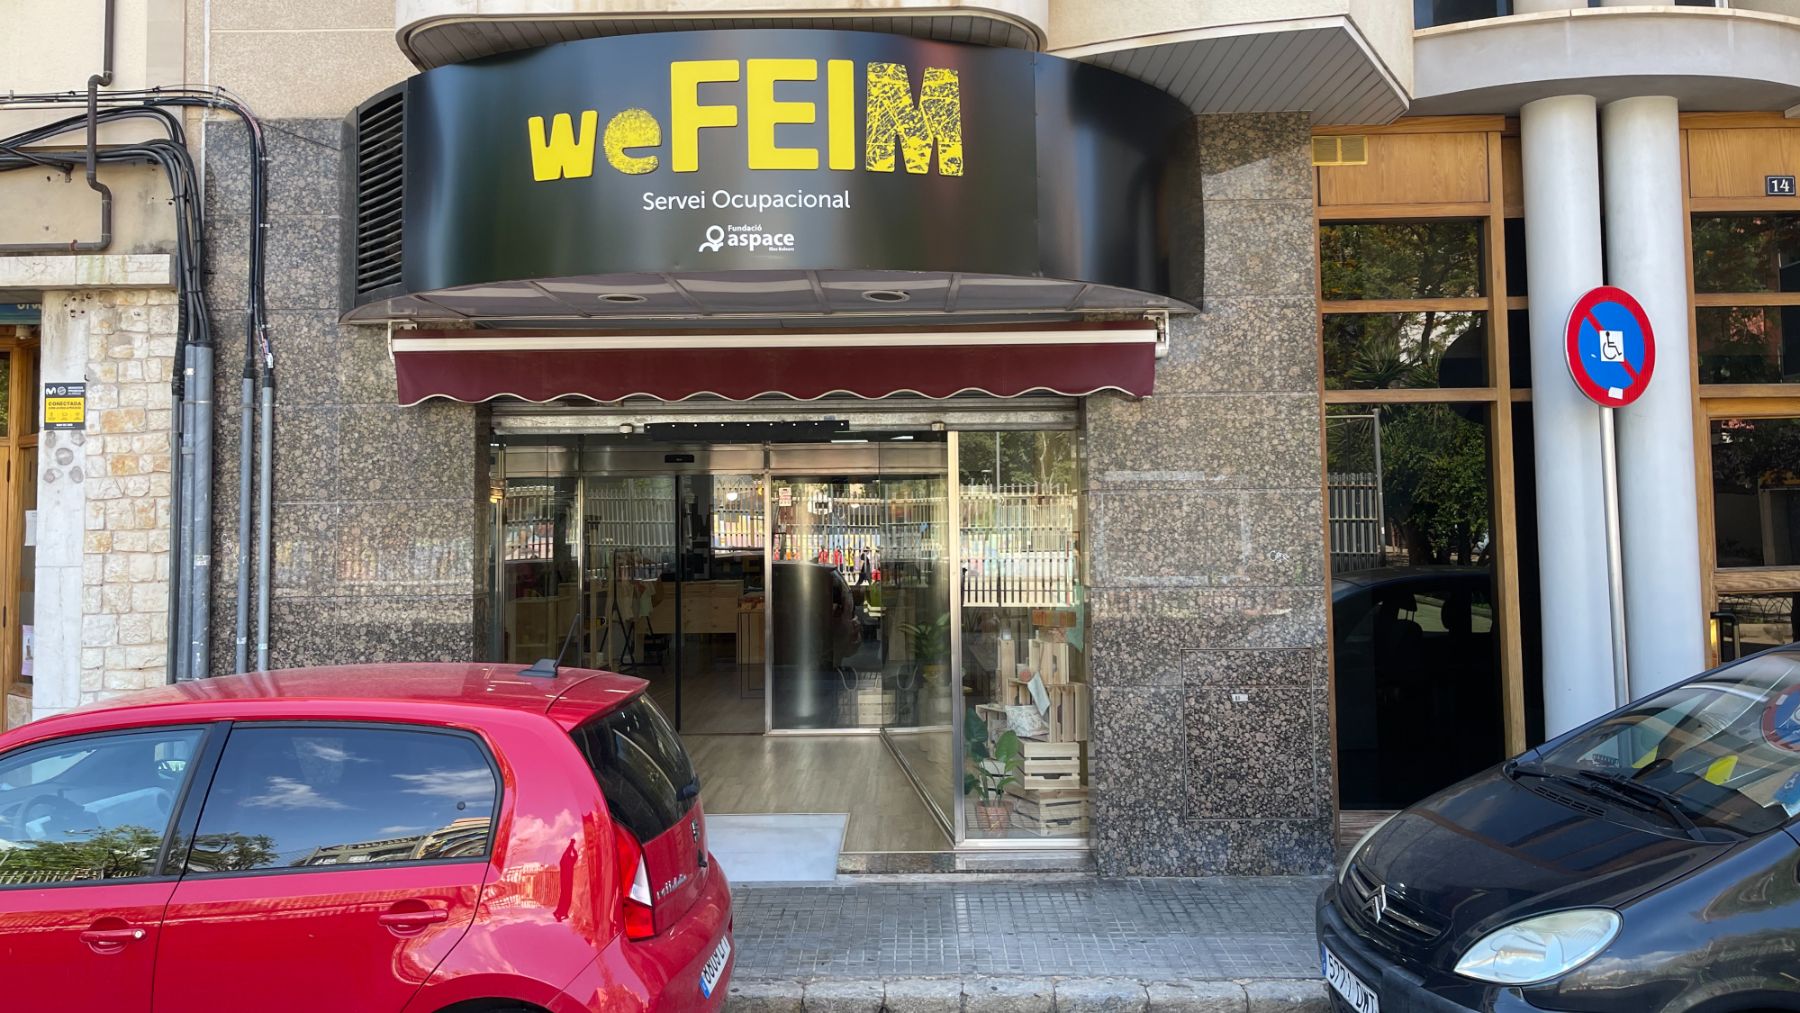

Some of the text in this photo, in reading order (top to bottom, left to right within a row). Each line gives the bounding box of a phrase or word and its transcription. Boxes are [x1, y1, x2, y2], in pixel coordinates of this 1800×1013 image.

[527, 58, 964, 182] weFEIM
[1771, 179, 1790, 192] 14
[642, 189, 851, 213] Servei Ocupacional
[727, 223, 762, 232] Fundació
[727, 233, 795, 251] aspace
